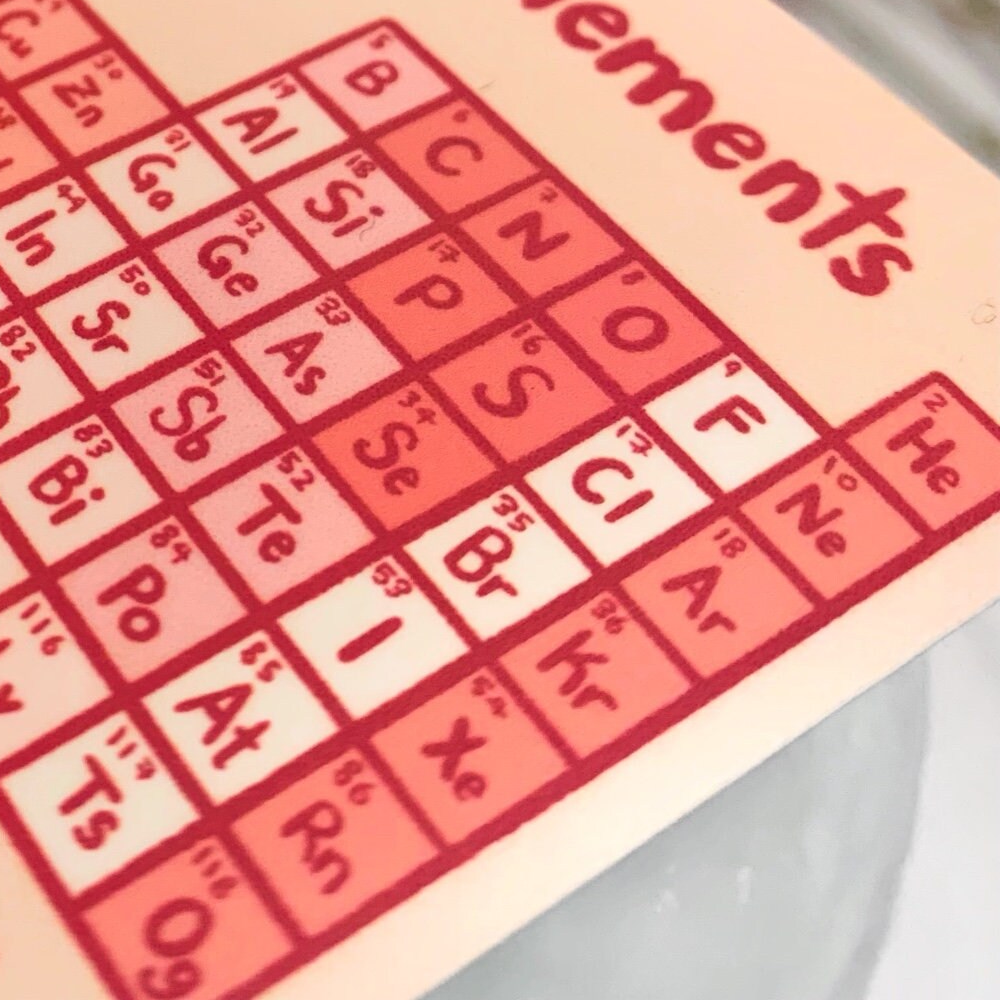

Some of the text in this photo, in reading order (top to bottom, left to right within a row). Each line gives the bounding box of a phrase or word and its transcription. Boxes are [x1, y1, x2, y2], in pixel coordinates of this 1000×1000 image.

[51, 74, 104, 129] Zn
[343, 60, 399, 97] B
[165, 129, 192, 153] 31
[425, 135, 484, 177] C
[344, 154, 378, 180] 18
[234, 208, 265, 239] 32
[303, 179, 385, 238] Si
[5, 209, 57, 267] In
[497, 209, 571, 261] N
[118, 263, 151, 297] 50
[197, 234, 259, 297] Ge
[621, 269, 648, 286] 8
[315, 296, 352, 327] 33
[393, 273, 464, 311] P
[71, 299, 131, 353] Sr
[510, 322, 543, 357] 16
[601, 305, 670, 354] O
[193, 357, 227, 388] 51
[263, 331, 327, 397] As
[724, 359, 743, 378] 9
[397, 389, 437, 425] 34
[471, 365, 555, 419] S
[693, 395, 767, 435] F
[922, 392, 949, 413] 2
[73, 423, 114, 459] 83
[149, 385, 227, 463] Sb
[615, 423, 654, 457] 17
[277, 450, 317, 494] 52
[352, 421, 421, 497] Se
[823, 455, 858, 492] 10
[885, 415, 961, 495] He
[27, 453, 105, 527] Bi
[492, 493, 535, 533] 35
[571, 457, 655, 523] Cl
[149, 523, 193, 565] 84
[236, 483, 303, 564] Te
[713, 527, 747, 559] 18
[775, 483, 847, 558] Ne
[370, 560, 414, 599] 53
[443, 525, 518, 598] Br
[96, 563, 167, 643] Po
[591, 598, 627, 635] 36
[661, 565, 737, 633] Ar
[20, 602, 65, 657] 116
[240, 641, 283, 683] 85
[535, 629, 619, 711] Kr
[471, 675, 507, 719] 54
[173, 683, 271, 770] At
[421, 716, 487, 801] Xe
[58, 755, 123, 851] Ts
[334, 759, 375, 806] 86
[279, 799, 351, 895] Rn
[137, 897, 215, 1000] Og
